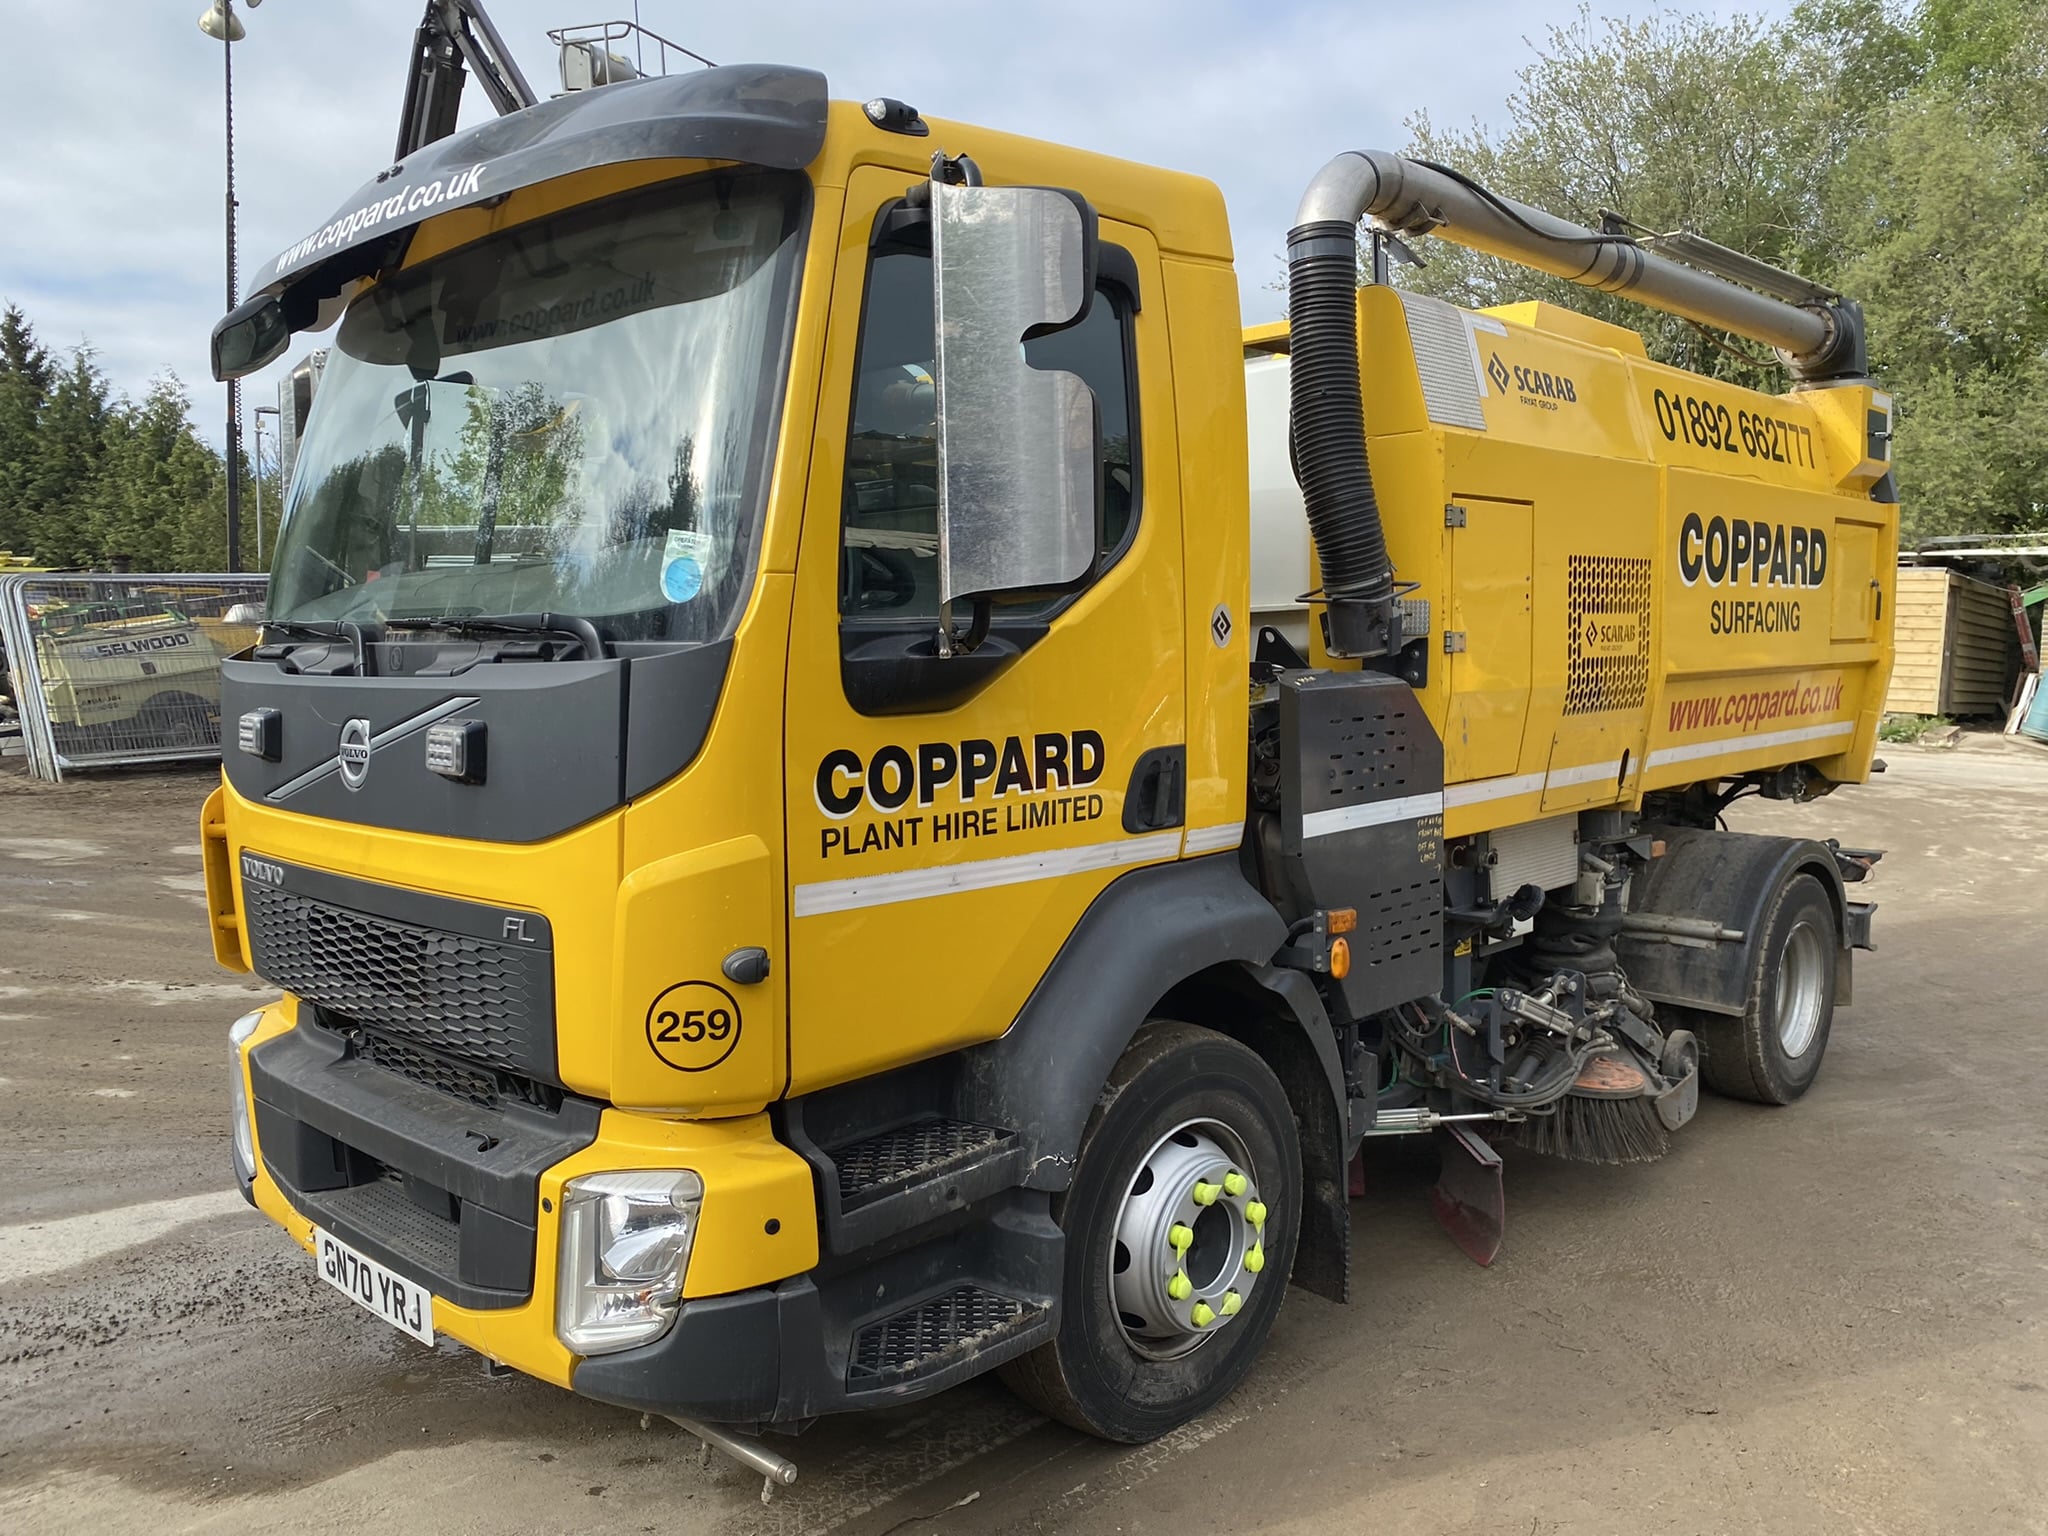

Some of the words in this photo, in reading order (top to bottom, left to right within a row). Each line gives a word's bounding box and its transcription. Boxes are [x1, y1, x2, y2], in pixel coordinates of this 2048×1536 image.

[275, 162, 487, 274] www.coppard.co.uk
[1514, 365, 1577, 403] SCARAB
[1653, 388, 1738, 453] 01892
[1739, 409, 1815, 470] 662777
[1678, 512, 1828, 589] COPPARD
[1600, 624, 1636, 642] SCARAB
[1711, 600, 1800, 635] SURFACING
[97, 633, 190, 657] SELWOOD
[1668, 677, 1844, 733] www.coppard.co.uk
[814, 729, 1105, 820] COPPARD
[821, 817, 923, 858] PLANT
[933, 808, 997, 842] HIRE
[1006, 794, 1103, 832] LIMITED
[241, 856, 284, 885] VOLVO
[503, 917, 535, 943] FL
[656, 1008, 731, 1042] 259
[324, 1239, 373, 1303] GN70
[378, 1272, 422, 1332] YRJ
